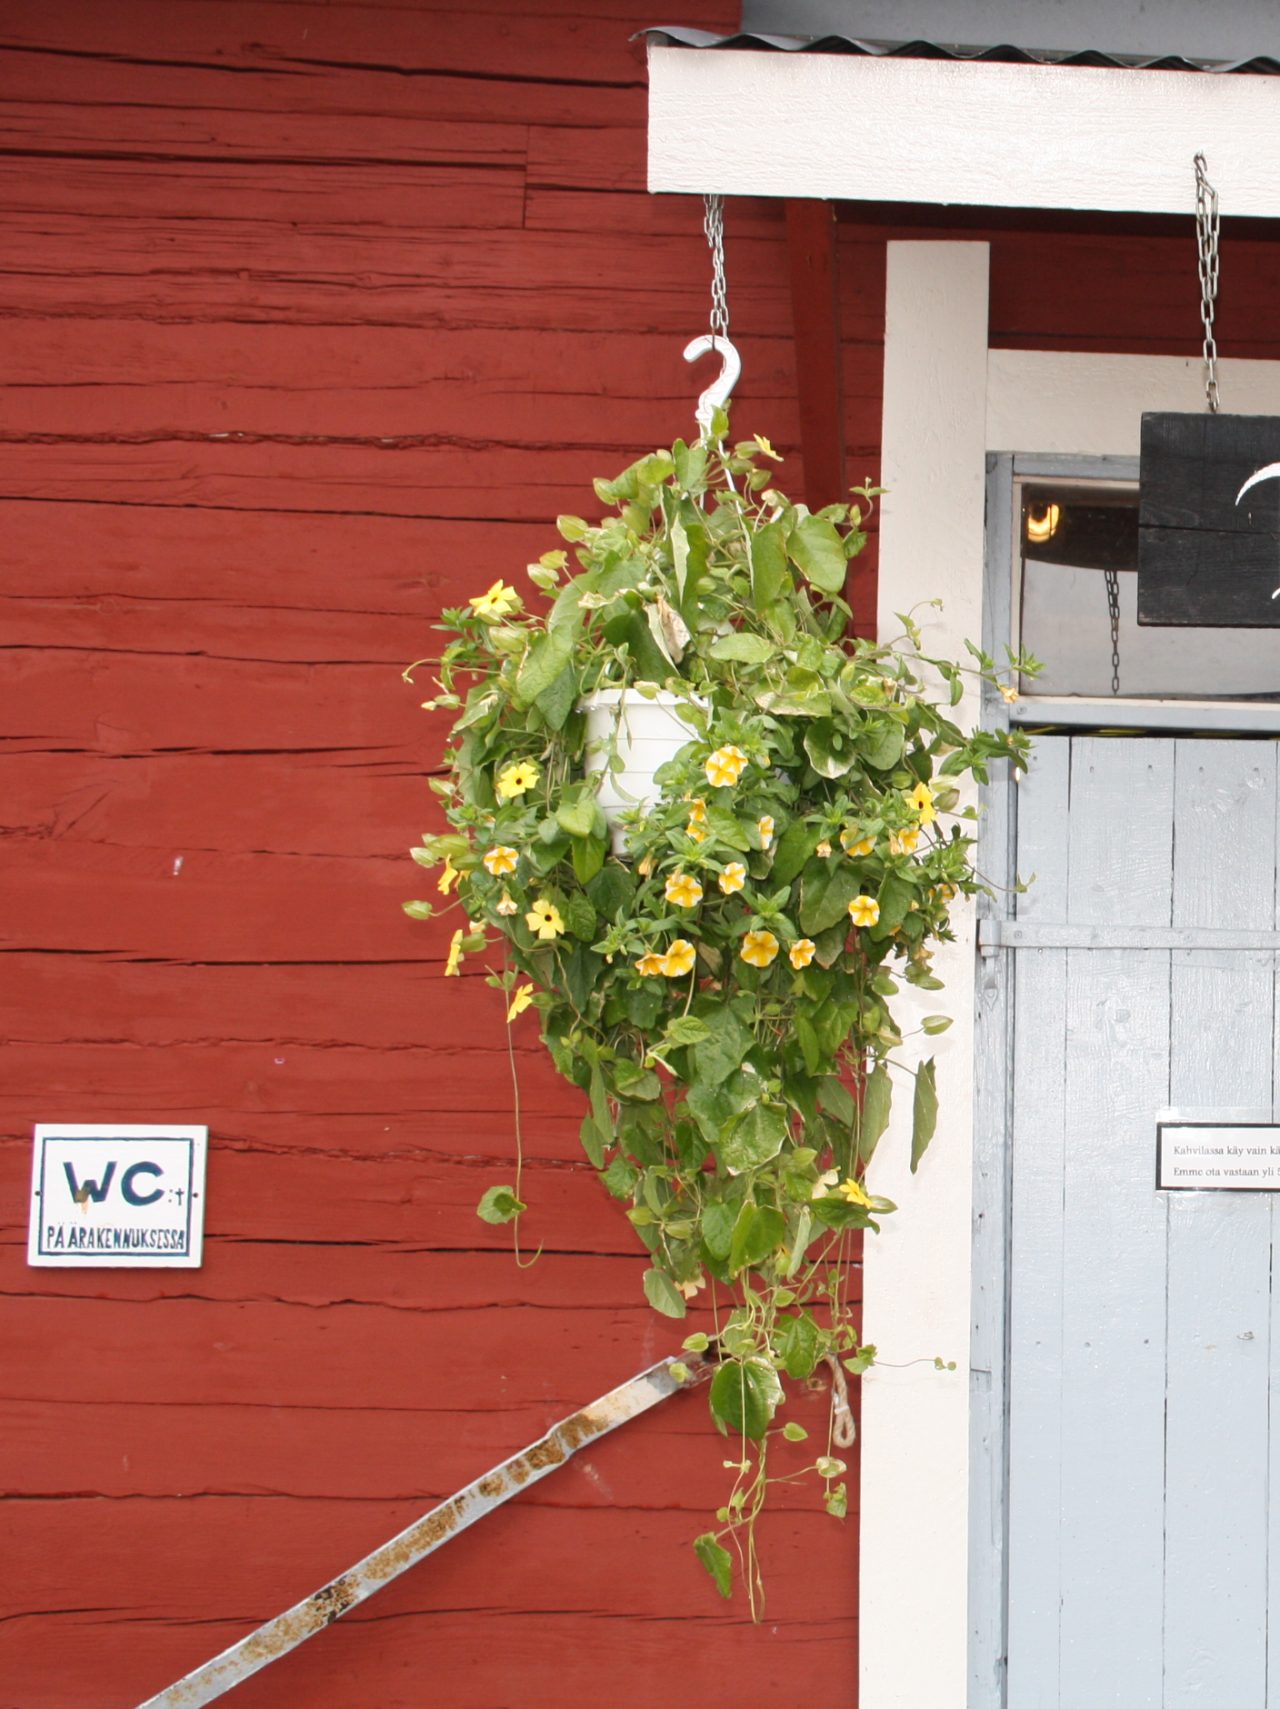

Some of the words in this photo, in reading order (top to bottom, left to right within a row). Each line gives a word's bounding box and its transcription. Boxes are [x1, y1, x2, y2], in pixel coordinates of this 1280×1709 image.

[1173, 1145, 1225, 1156] Kahvilassa
[1226, 1145, 1244, 1158] käy
[1246, 1145, 1268, 1156] vain
[1173, 1166, 1204, 1177] Emme
[1204, 1167, 1222, 1177] ota
[1222, 1167, 1260, 1177] vastaan
[1261, 1166, 1275, 1179] yli
[46, 1221, 186, 1250] PÄÄRAKENNUKSESSA
